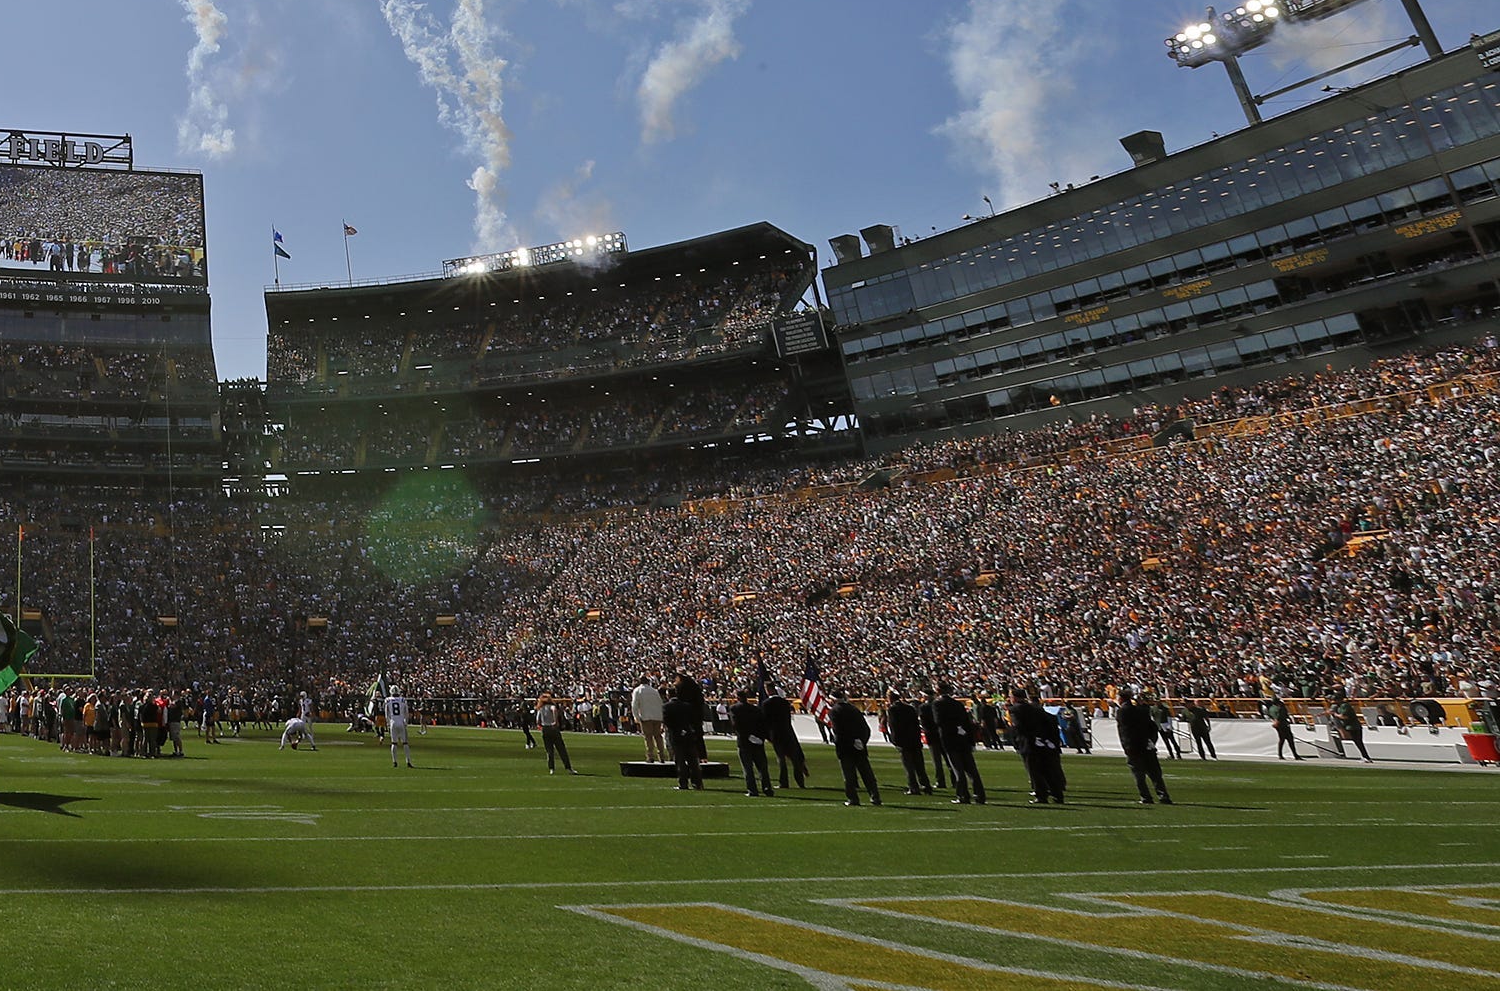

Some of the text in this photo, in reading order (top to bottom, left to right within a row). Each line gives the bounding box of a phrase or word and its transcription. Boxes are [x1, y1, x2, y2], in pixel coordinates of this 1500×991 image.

[10, 137, 104, 165] FIELD
[46, 294, 63, 302] 1965
[69, 295, 87, 303] 1966
[141, 297, 160, 305] 2010
[392, 702, 400, 716] 8
